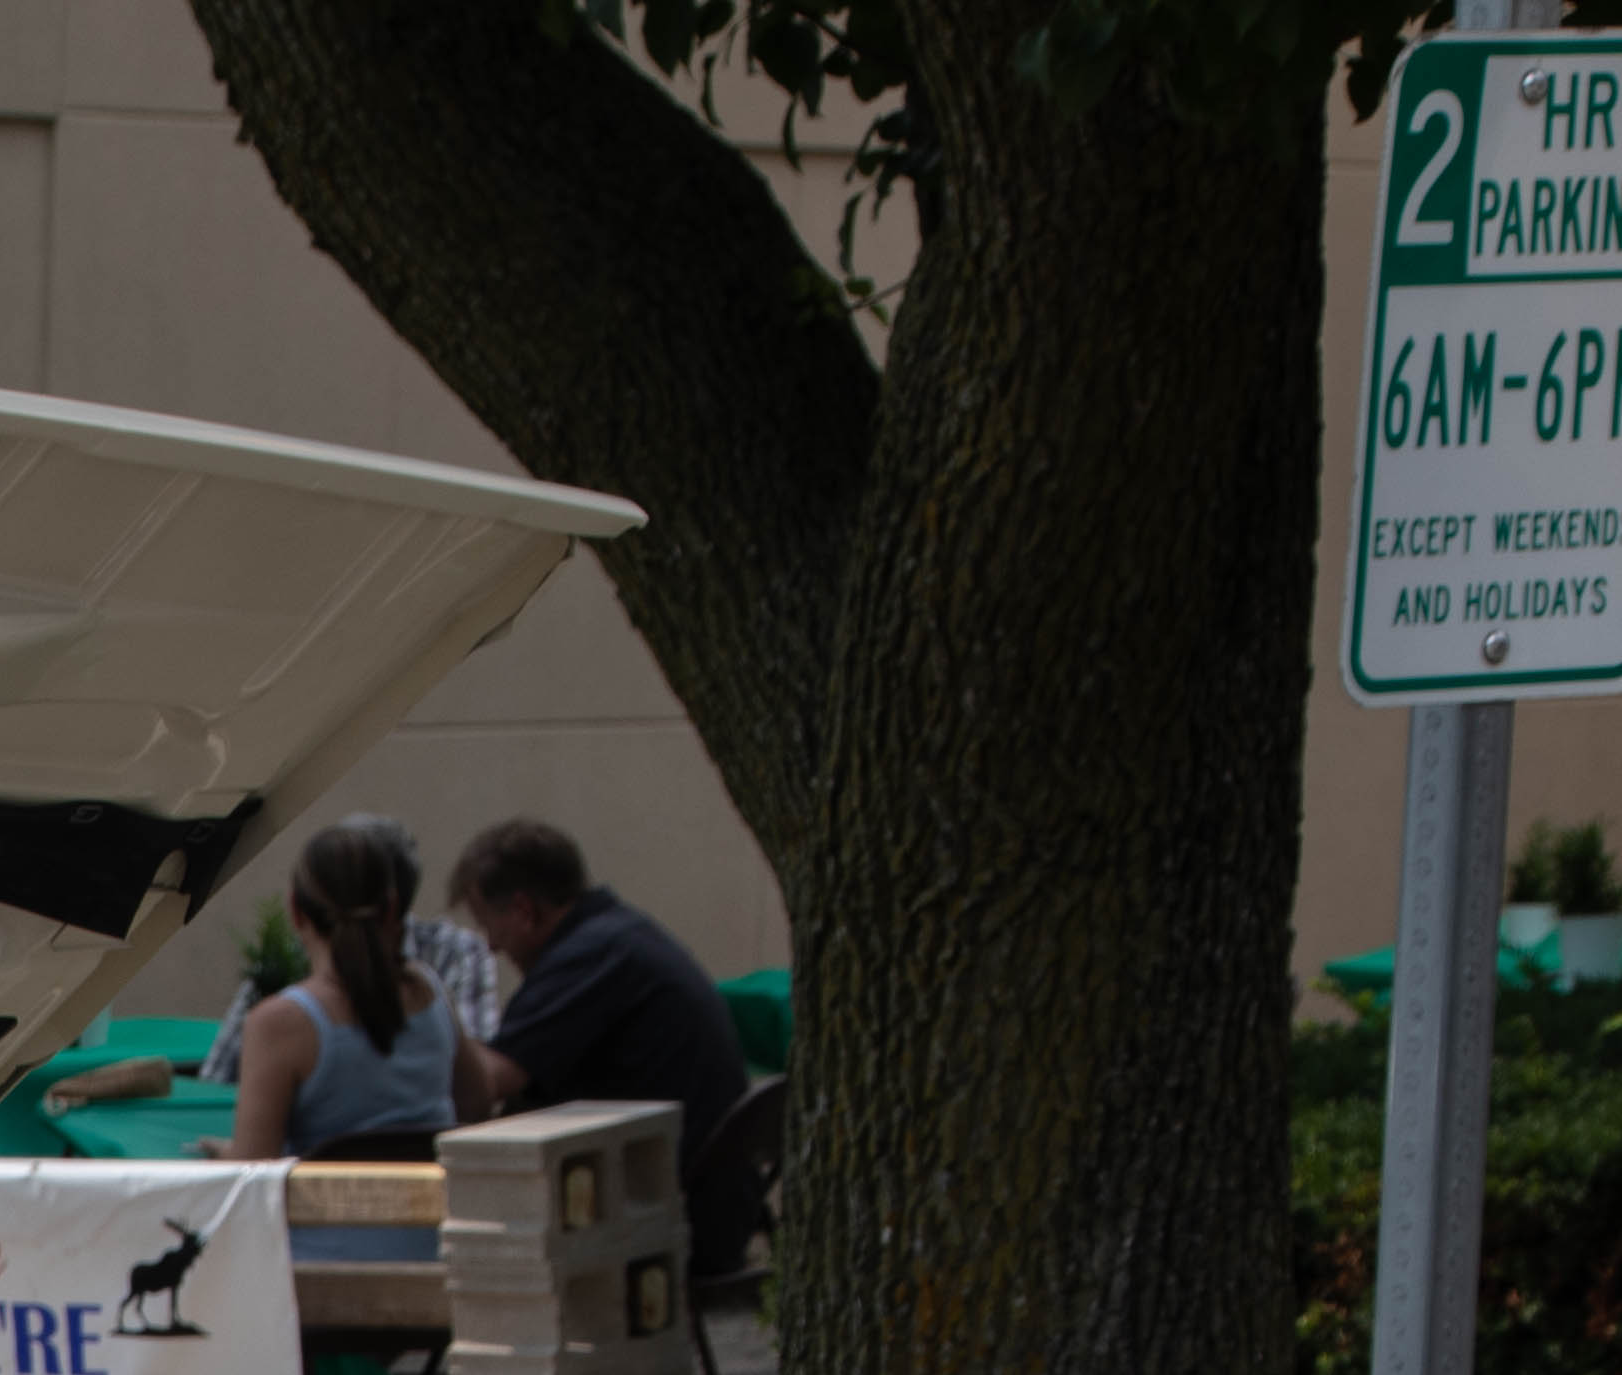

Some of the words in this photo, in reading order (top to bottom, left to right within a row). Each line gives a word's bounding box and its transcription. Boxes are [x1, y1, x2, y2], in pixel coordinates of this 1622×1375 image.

[1543, 70, 1616, 151] HR
[1395, 88, 1465, 247] 2
[1382, 326, 1622, 450] 6AM-6P
[1372, 514, 1476, 560] EXCEPT
[1493, 507, 1622, 554] WEEKEND
[1392, 585, 1451, 627] AND
[1463, 576, 1609, 622] HOLIDAYS
